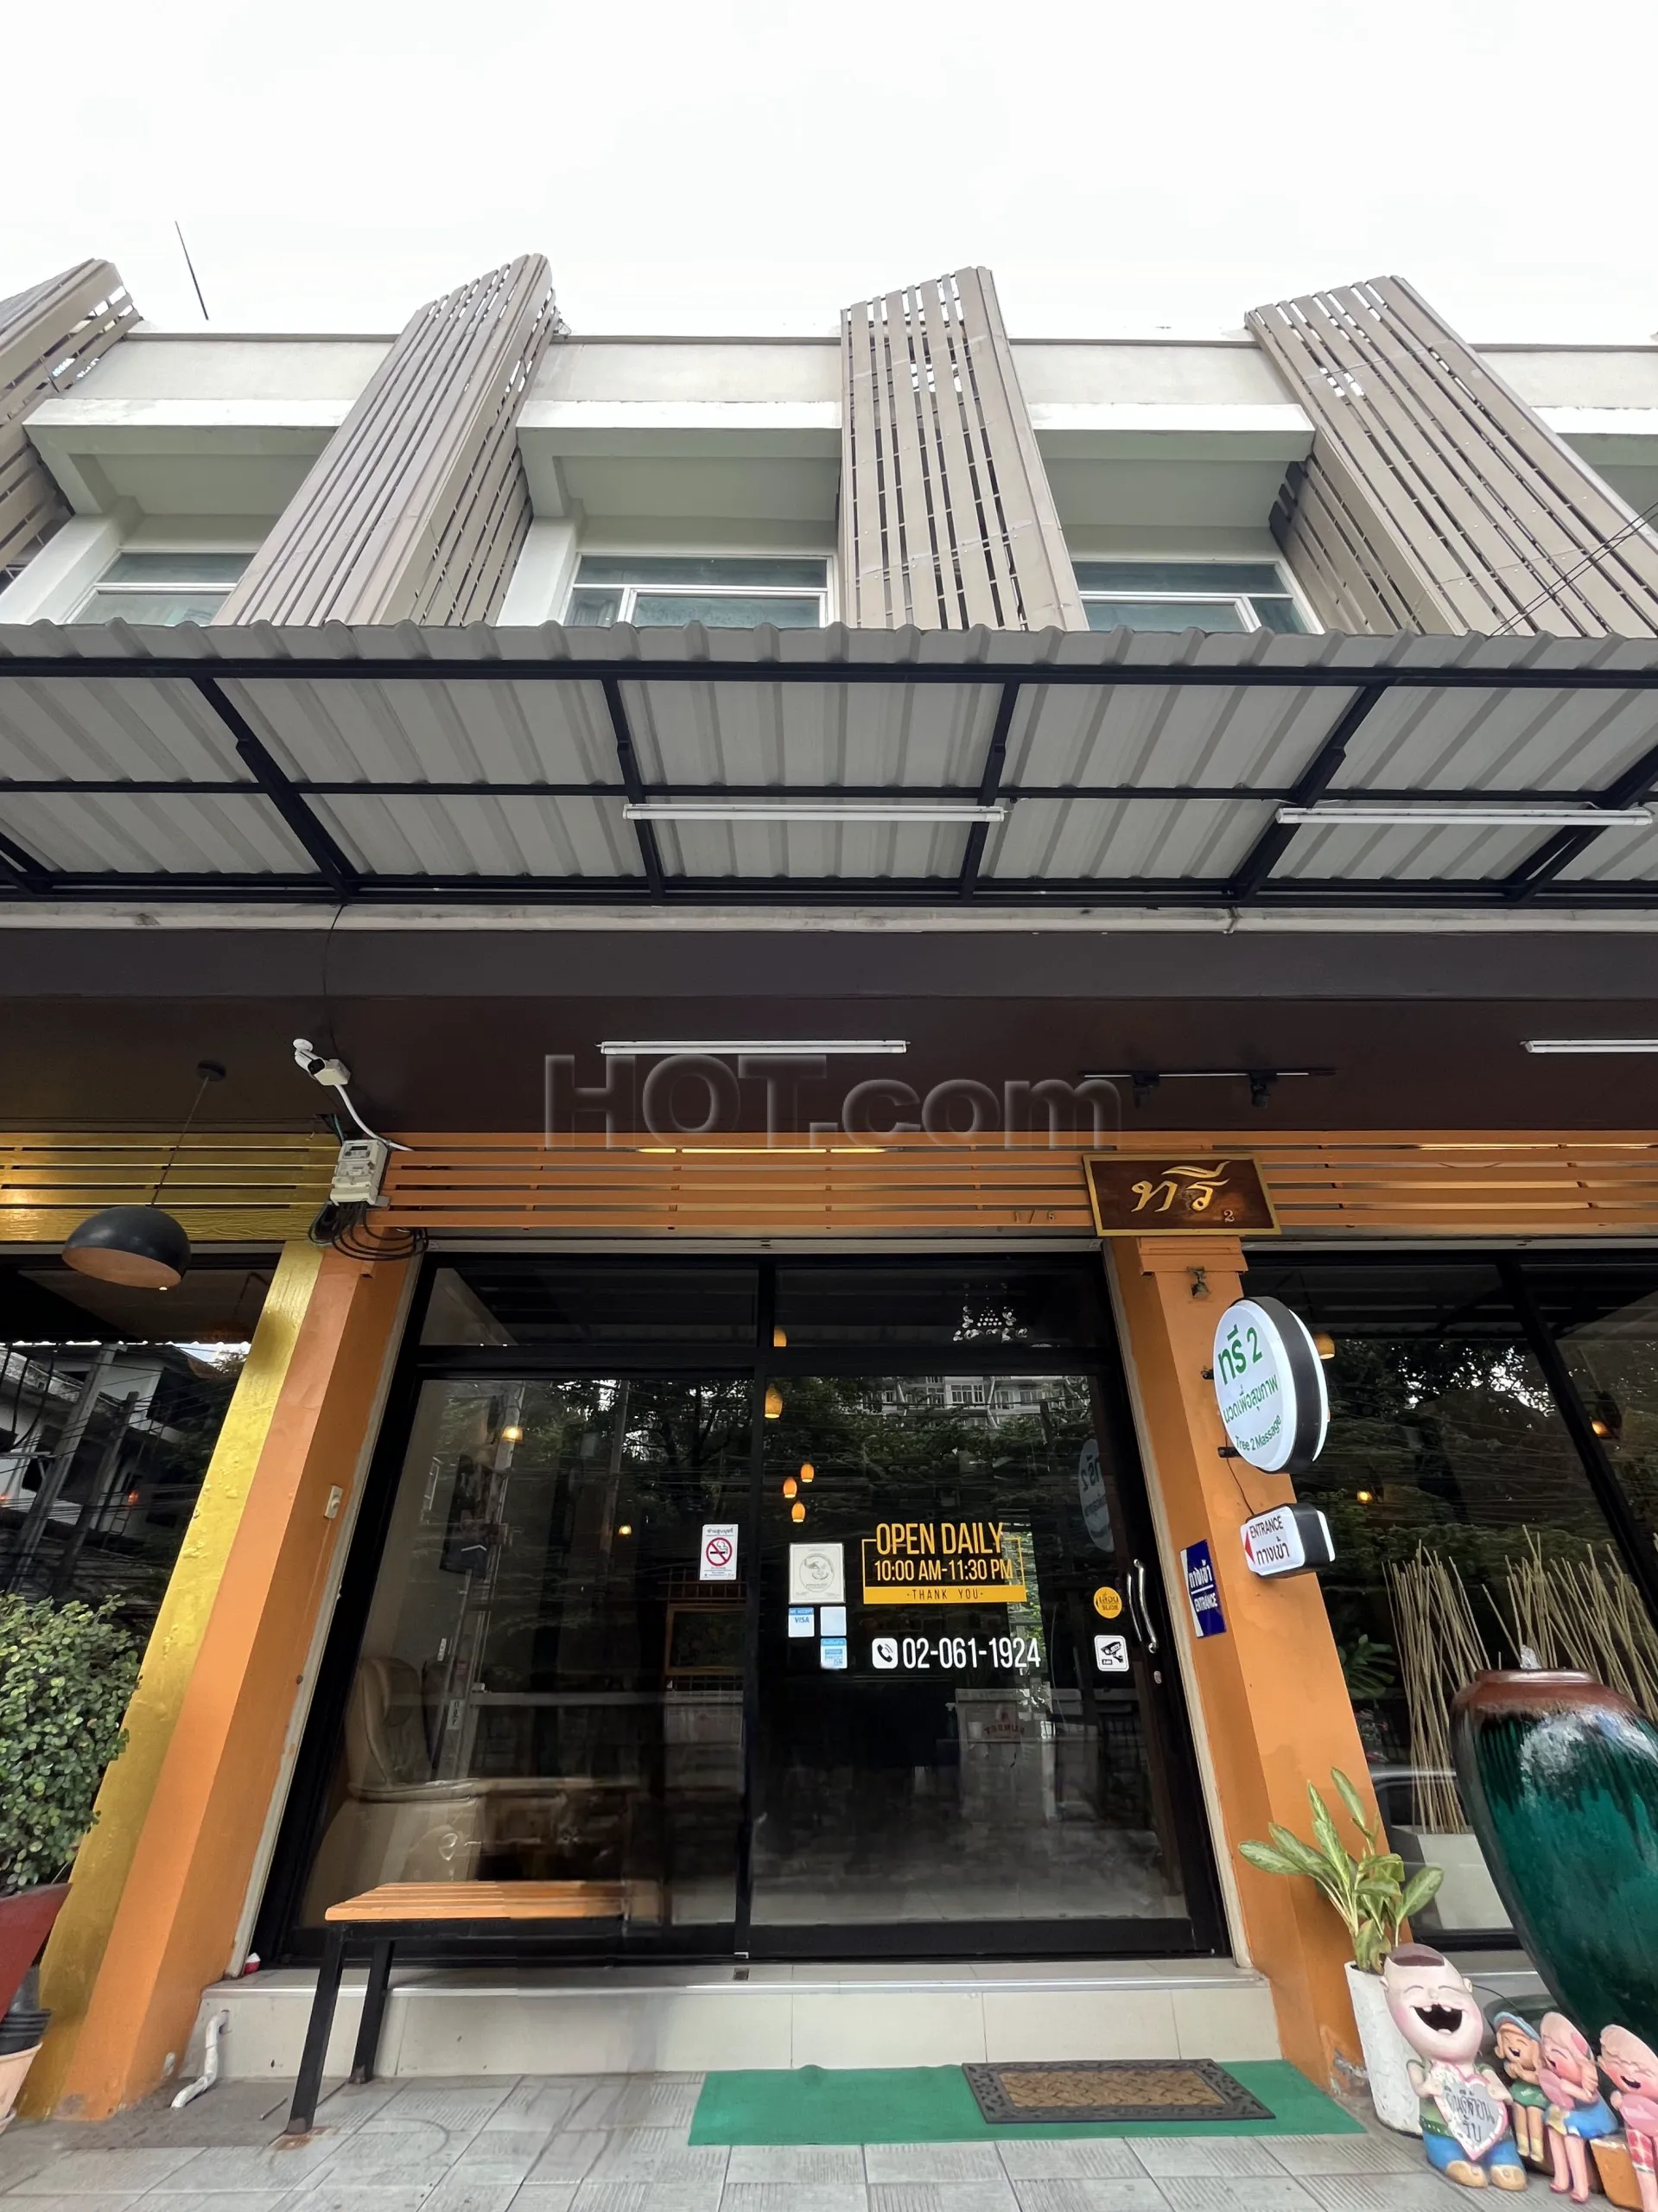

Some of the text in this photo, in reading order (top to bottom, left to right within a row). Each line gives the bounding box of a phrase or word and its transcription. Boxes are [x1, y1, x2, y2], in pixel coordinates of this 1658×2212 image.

[1223, 1209, 1236, 1223] 2
[1217, 1323, 1263, 1385] ทรี 2
[1223, 1373, 1280, 1425] นวดเพื่อสุขภาพ
[1235, 1414, 1283, 1452] Tree 2 Massage
[875, 1522, 1004, 1555] OPEN DAILY
[1248, 1515, 1284, 1539] ENTRANCE
[1255, 1535, 1291, 1566] ทางเข้า
[874, 1558, 1014, 1581] 10:00 AM-11:30 PM
[1187, 1558, 1214, 1589] ทางเข้า
[1193, 1592, 1218, 1613] ENTRANCE
[902, 1637, 1042, 1669] 02-061-1924
